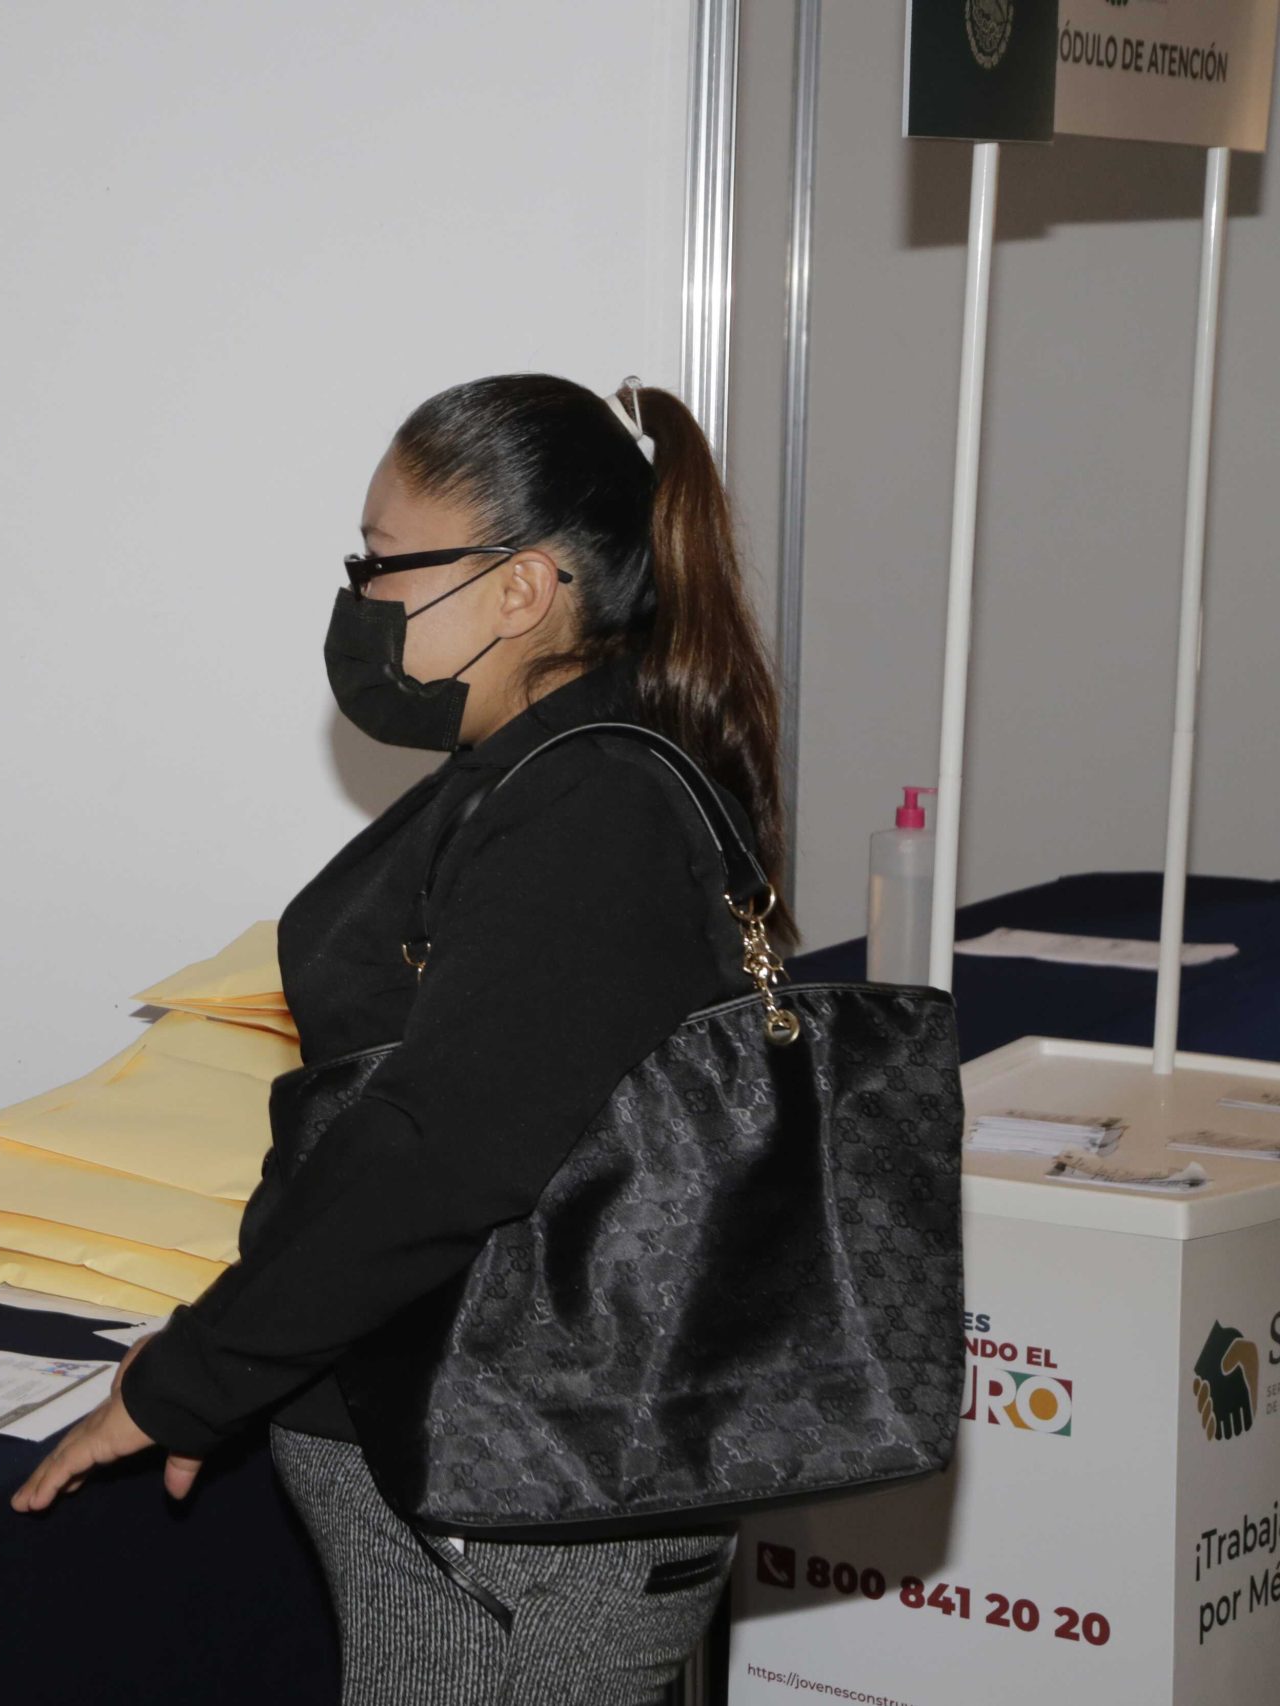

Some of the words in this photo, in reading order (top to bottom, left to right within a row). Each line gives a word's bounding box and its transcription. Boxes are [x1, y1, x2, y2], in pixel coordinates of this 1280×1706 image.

[1058, 19, 1118, 69] ÓDULO
[1121, 37, 1145, 73] DE
[1147, 42, 1228, 83] ATENCIÓN
[1026, 1346, 1058, 1369] EL
[1196, 1500, 1280, 1582] ¡Trabaj
[806, 1556, 886, 1600] 800
[900, 1575, 970, 1619] 841
[985, 1593, 1040, 1632] 20
[1054, 1606, 1111, 1647] 20
[1200, 1589, 1241, 1645] por
